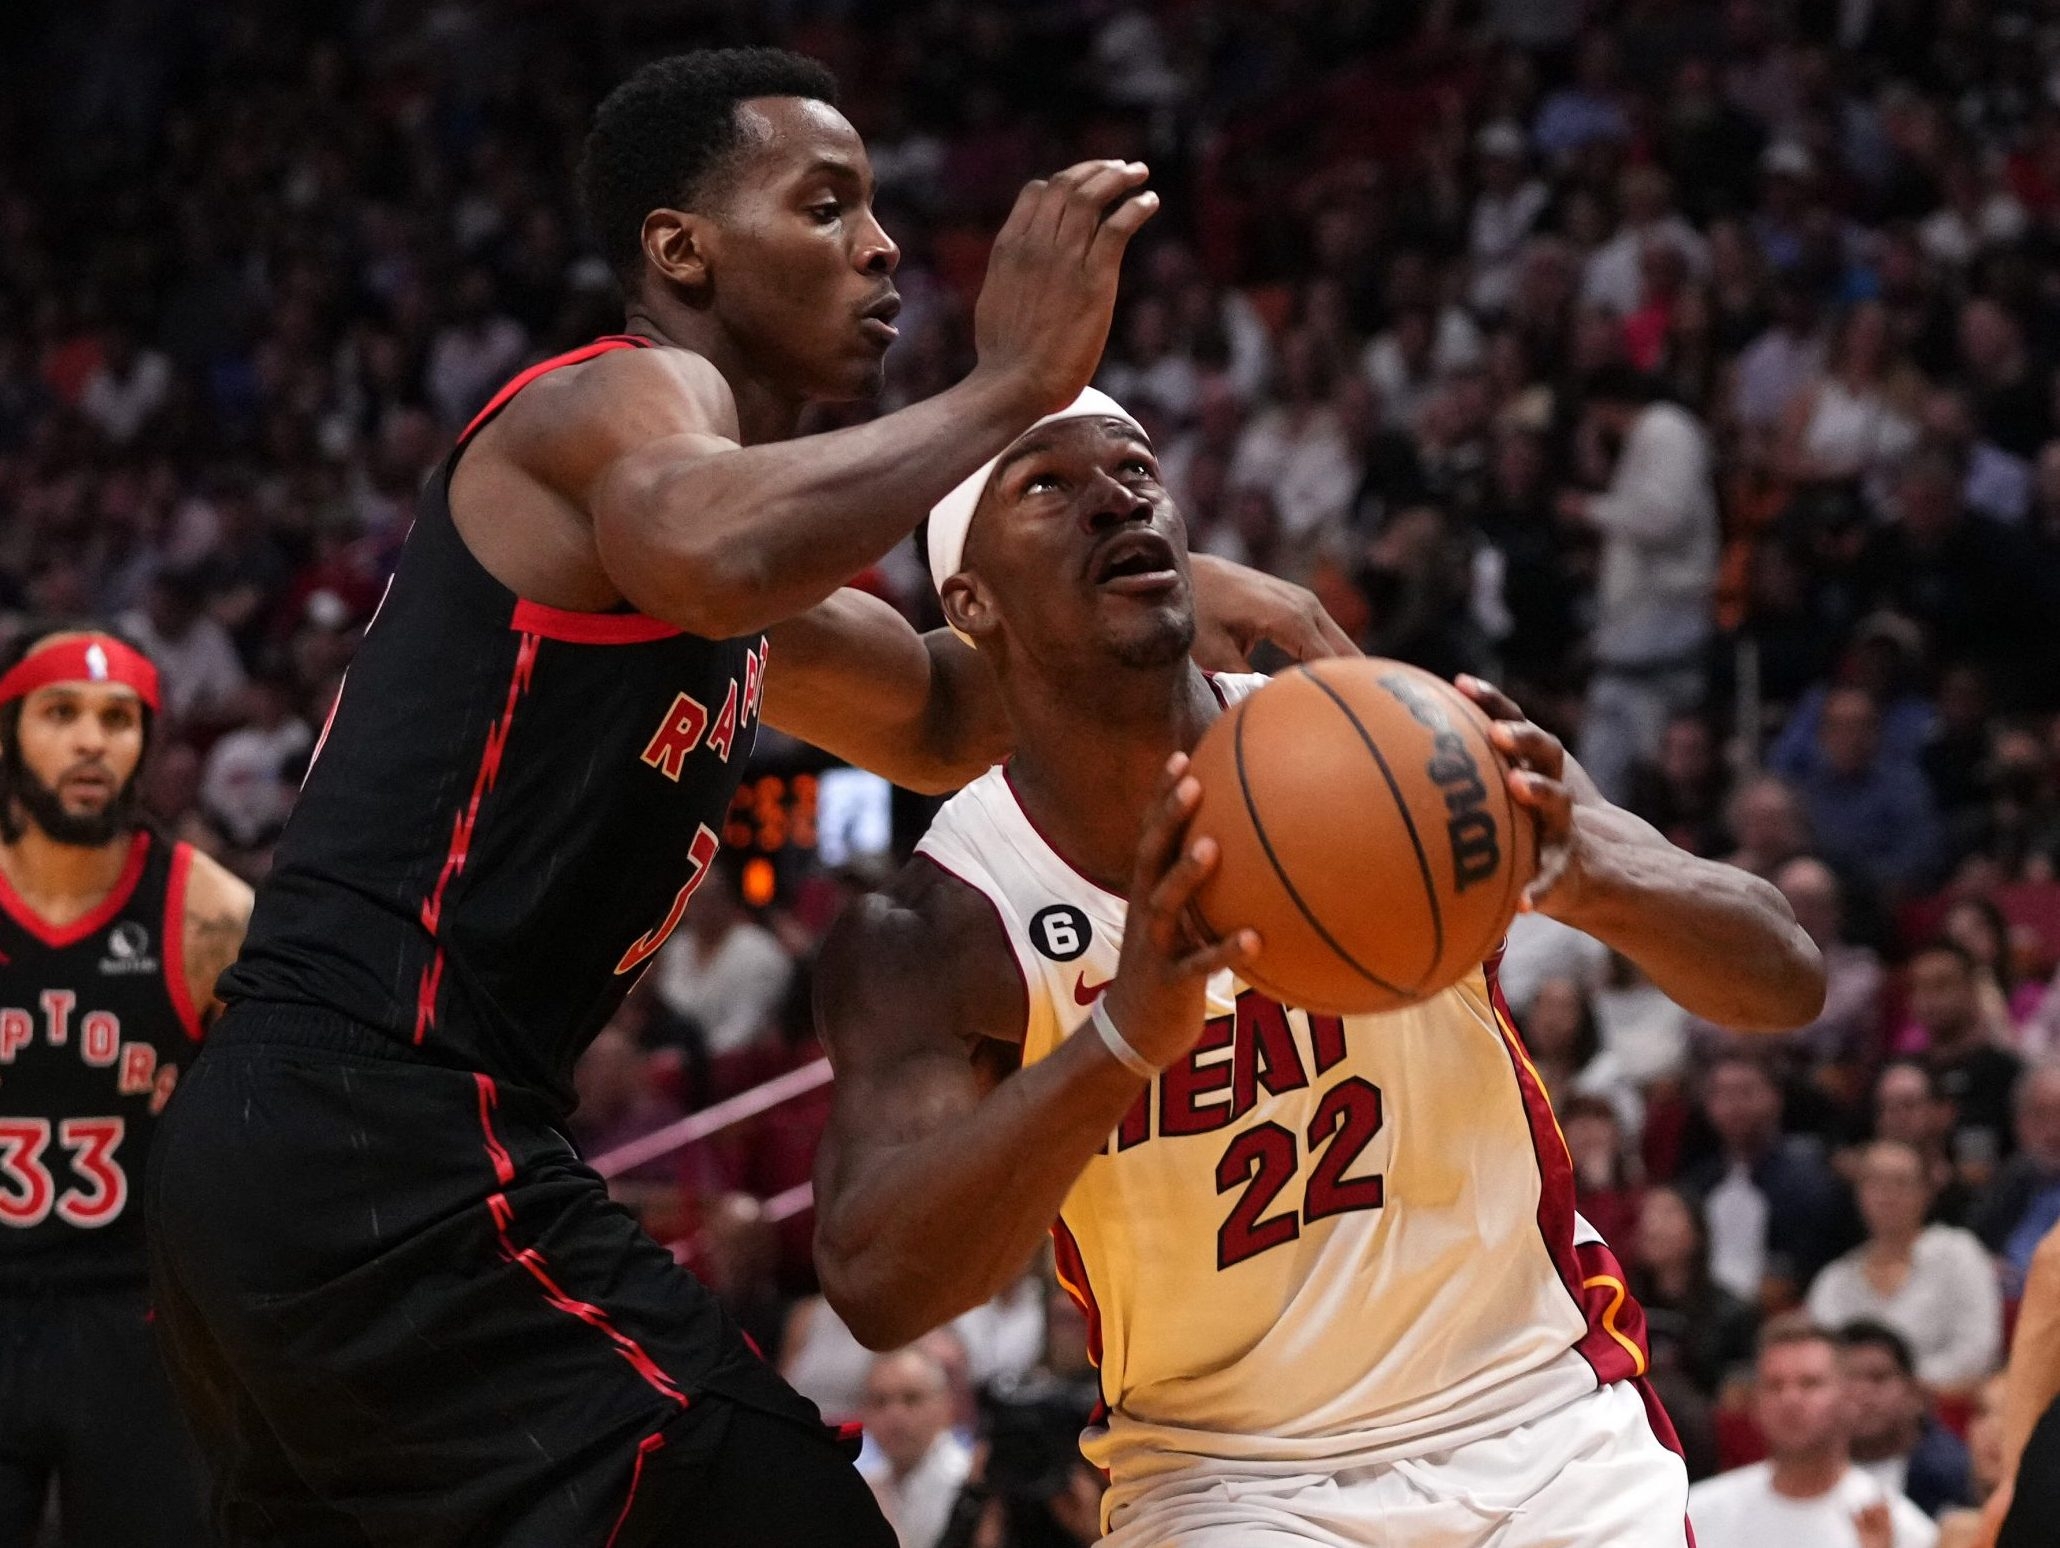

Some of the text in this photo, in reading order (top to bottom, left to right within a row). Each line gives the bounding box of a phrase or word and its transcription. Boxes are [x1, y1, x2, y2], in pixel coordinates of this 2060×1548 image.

[1042, 911, 1080, 955] 6
[0, 988, 178, 1115] PTORS
[1097, 987, 1347, 1156] EA
[0, 1116, 127, 1229] 33
[1215, 1075, 1383, 1272] 22
